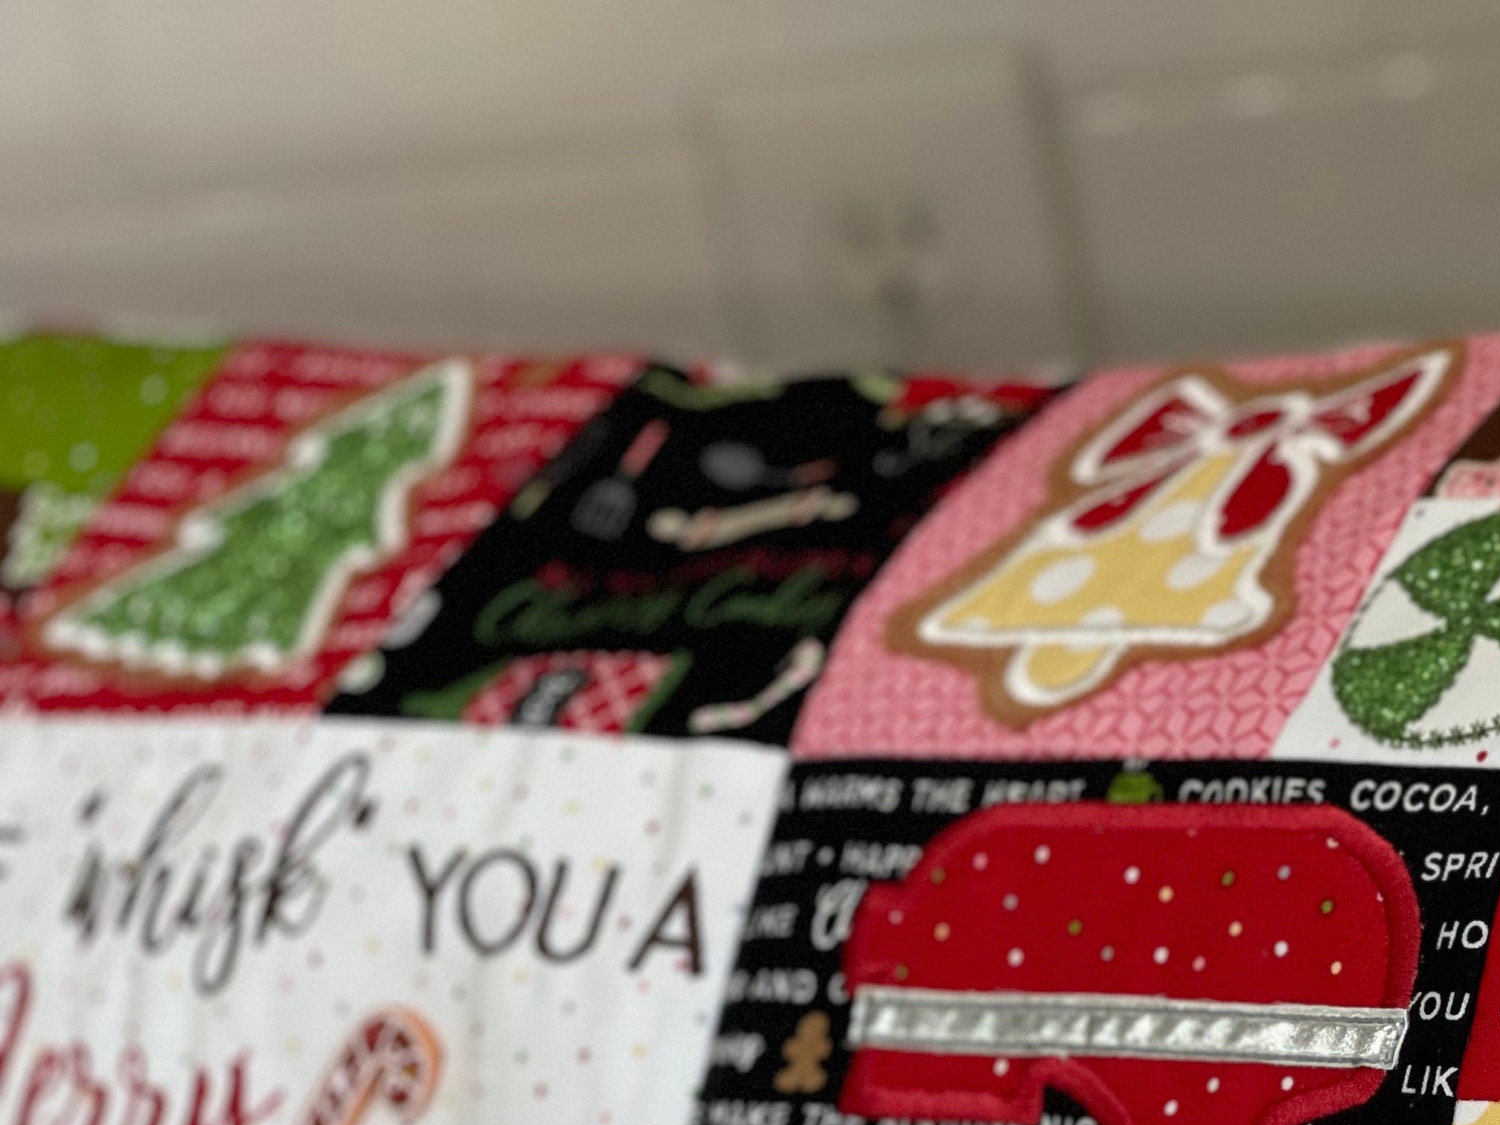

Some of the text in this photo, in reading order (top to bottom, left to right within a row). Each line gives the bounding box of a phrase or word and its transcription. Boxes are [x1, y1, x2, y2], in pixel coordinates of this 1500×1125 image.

[909, 776, 976, 814] THE
[1178, 776, 1326, 804] COOKIES
[1350, 779, 1489, 817] COCOA,
[409, 843, 623, 964] YOU
[627, 866, 706, 975] A
[1436, 919, 1489, 950] HO
[1401, 1064, 1459, 1097] LIK
